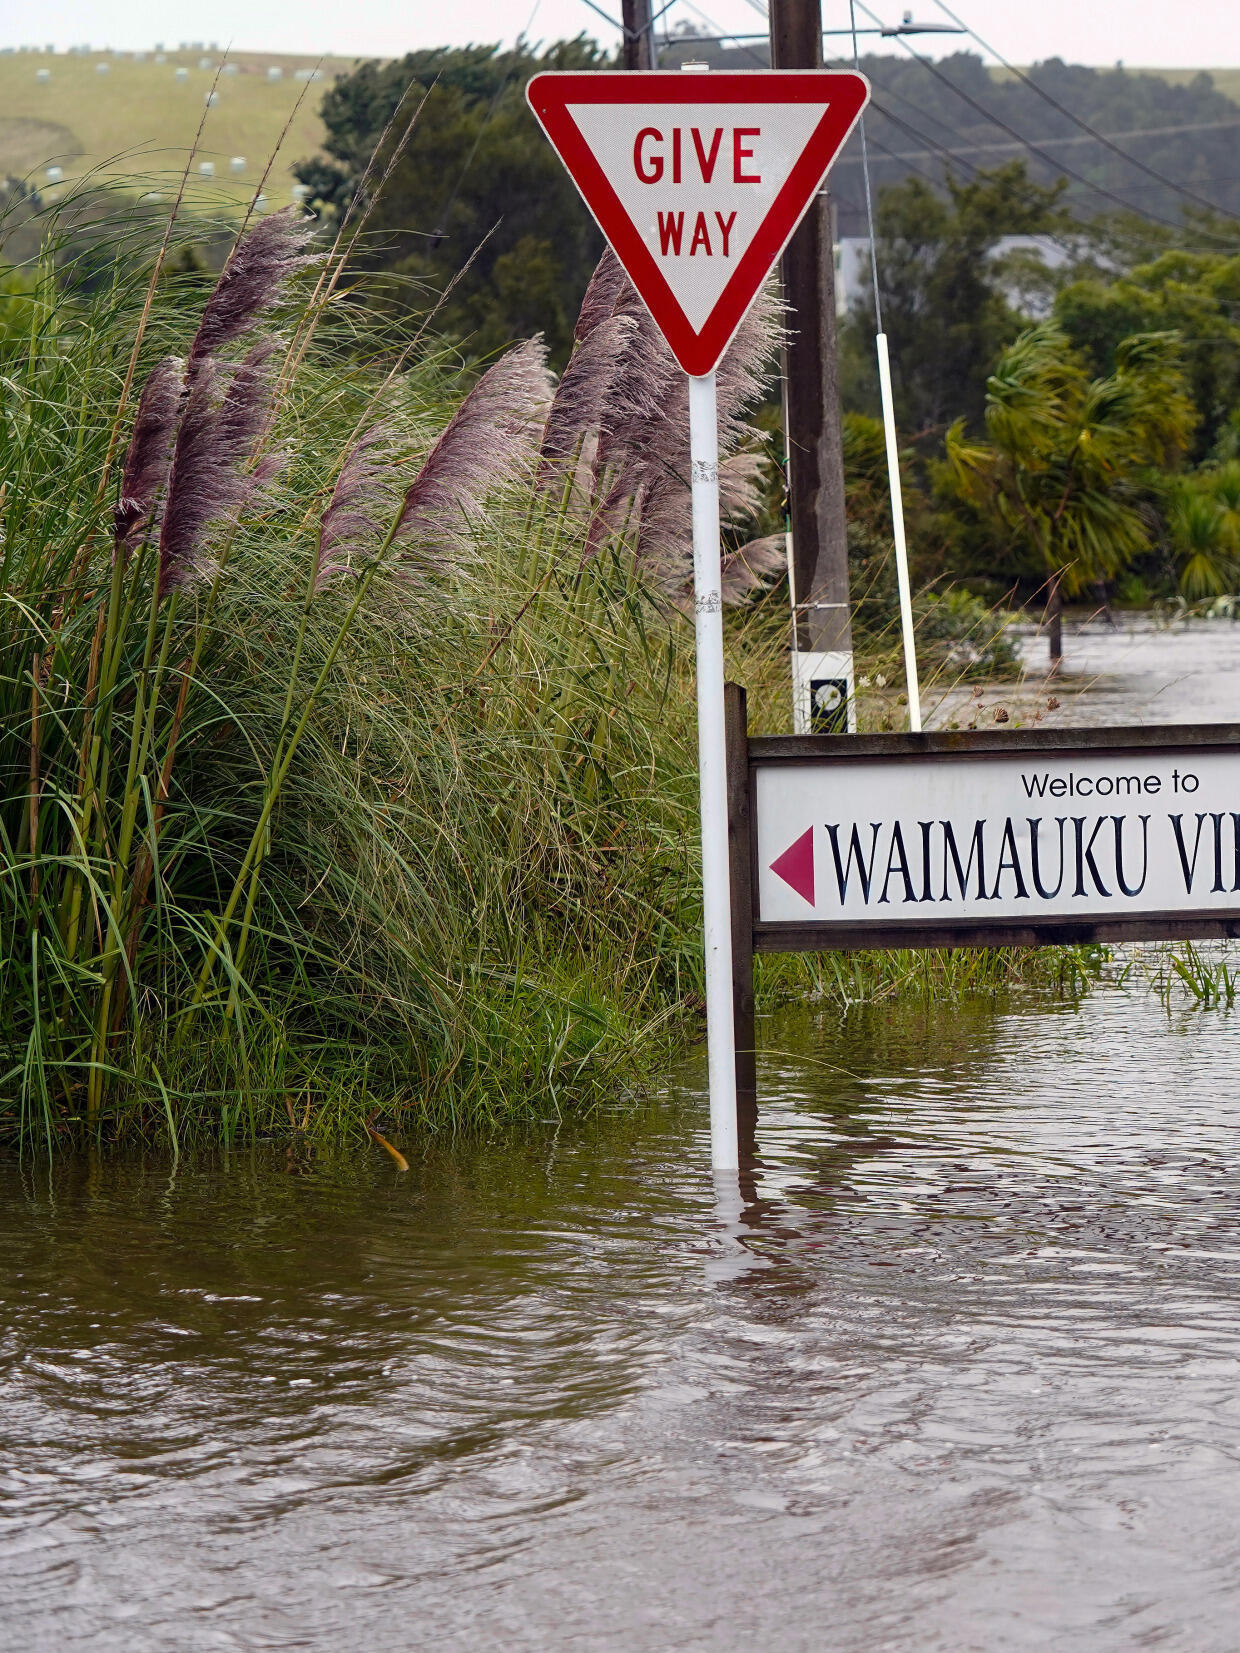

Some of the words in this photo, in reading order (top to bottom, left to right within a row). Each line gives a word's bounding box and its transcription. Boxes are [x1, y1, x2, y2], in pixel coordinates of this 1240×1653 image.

[633, 127, 761, 185] GIVE
[656, 211, 738, 257] WAY
[1021, 772, 1162, 798] Welcome
[1171, 769, 1200, 794] to
[824, 813, 1152, 907] WAIMAUKU
